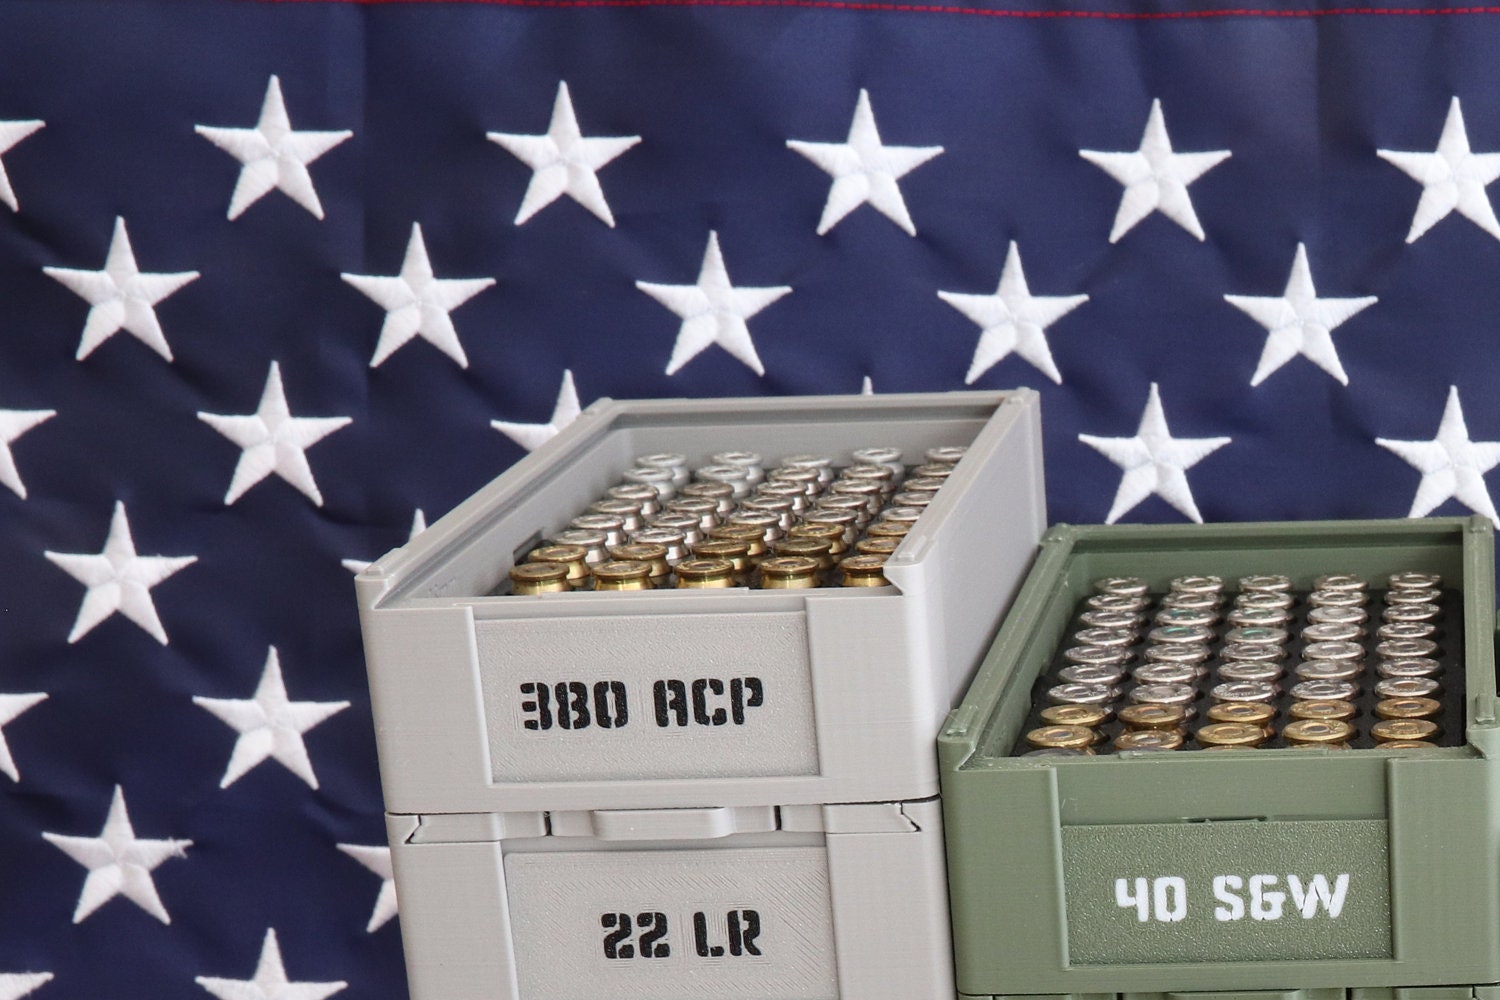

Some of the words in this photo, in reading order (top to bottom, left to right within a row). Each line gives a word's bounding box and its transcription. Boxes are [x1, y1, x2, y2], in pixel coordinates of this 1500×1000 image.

[519, 680, 629, 731] 380
[652, 676, 764, 728] ACP
[1115, 876, 1188, 923] 40
[1212, 873, 1350, 922] S&W
[600, 911, 671, 960] 22
[693, 909, 762, 958] LR
